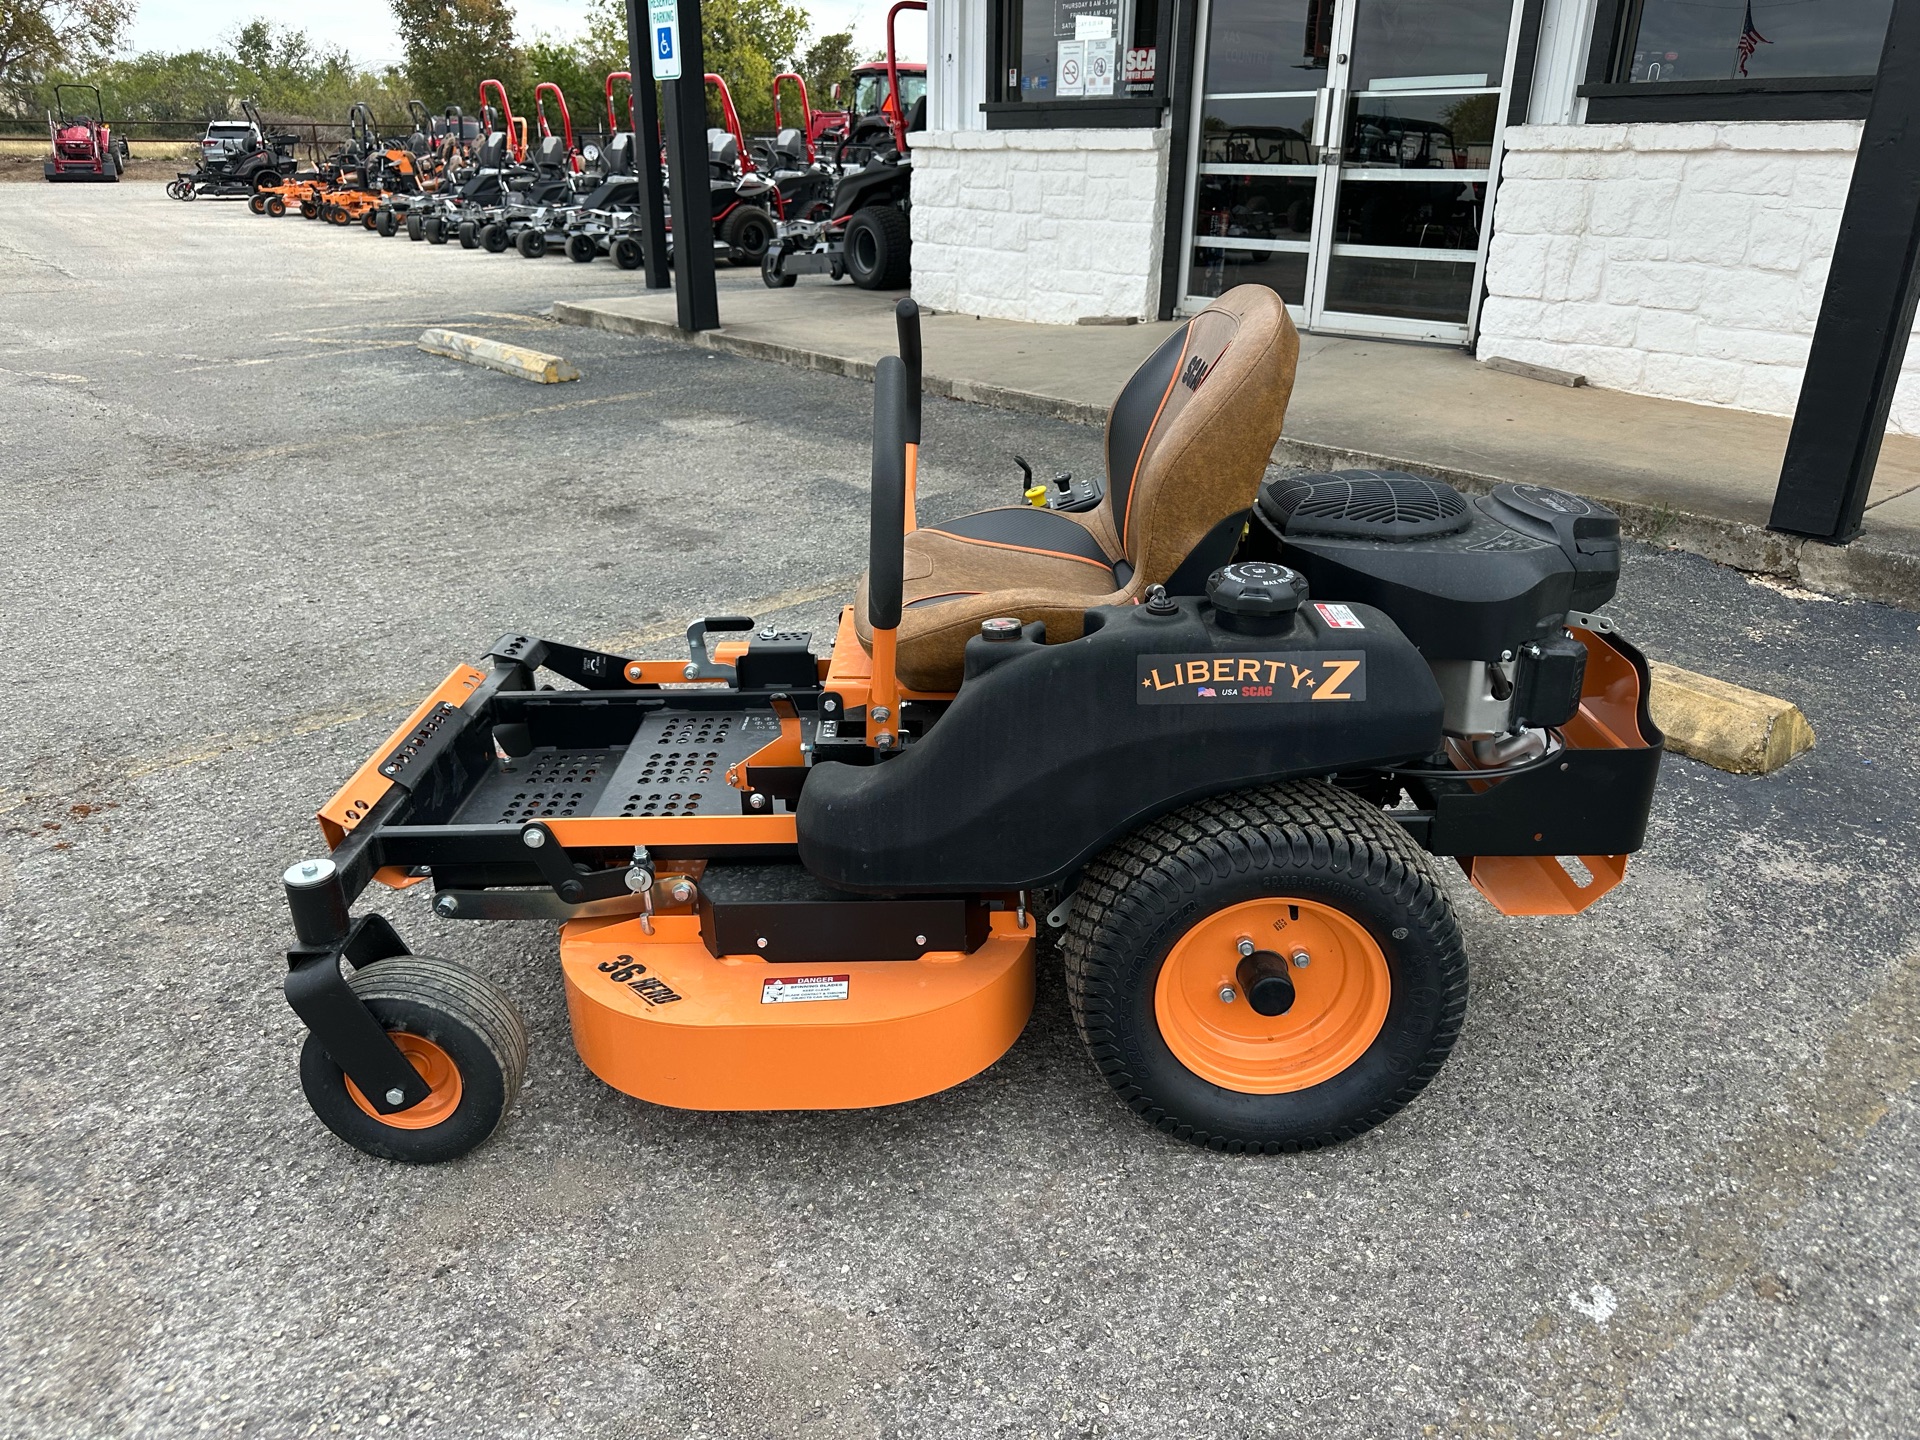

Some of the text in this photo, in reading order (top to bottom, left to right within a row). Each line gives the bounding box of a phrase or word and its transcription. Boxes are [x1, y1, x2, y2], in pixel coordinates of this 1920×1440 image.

[653, 10, 674, 24] PARKING
[1062, 2, 1088, 10] THURSDAY
[1126, 49, 1156, 71] SCA
[1150, 658, 1361, 700] LIBERTY Z
[1221, 686, 1273, 697] USA SCAG
[1123, 900, 1198, 992] MASTER
[598, 954, 683, 1005] 36 HERO
